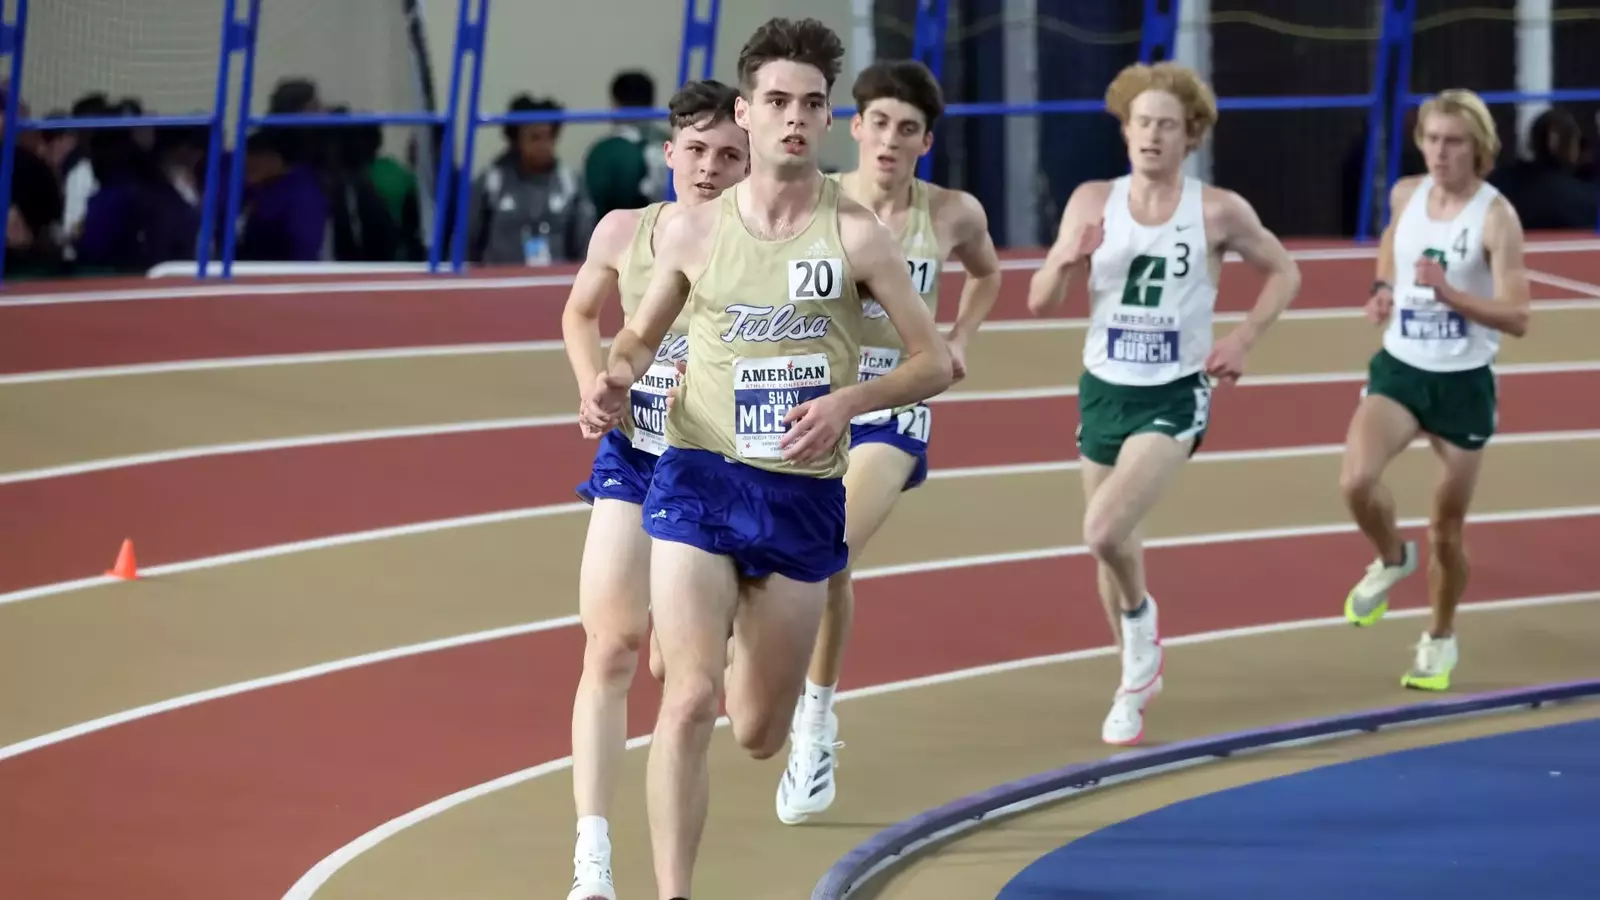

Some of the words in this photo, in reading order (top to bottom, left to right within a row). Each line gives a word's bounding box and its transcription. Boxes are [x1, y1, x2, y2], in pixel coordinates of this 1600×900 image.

[1173, 242, 1190, 278] 3
[1453, 228, 1468, 260] 4
[795, 260, 834, 298] 20
[720, 303, 832, 342] Tulsa
[741, 361, 825, 382] AMERICAN
[768, 390, 800, 405] SHAY
[902, 408, 927, 440] 21
